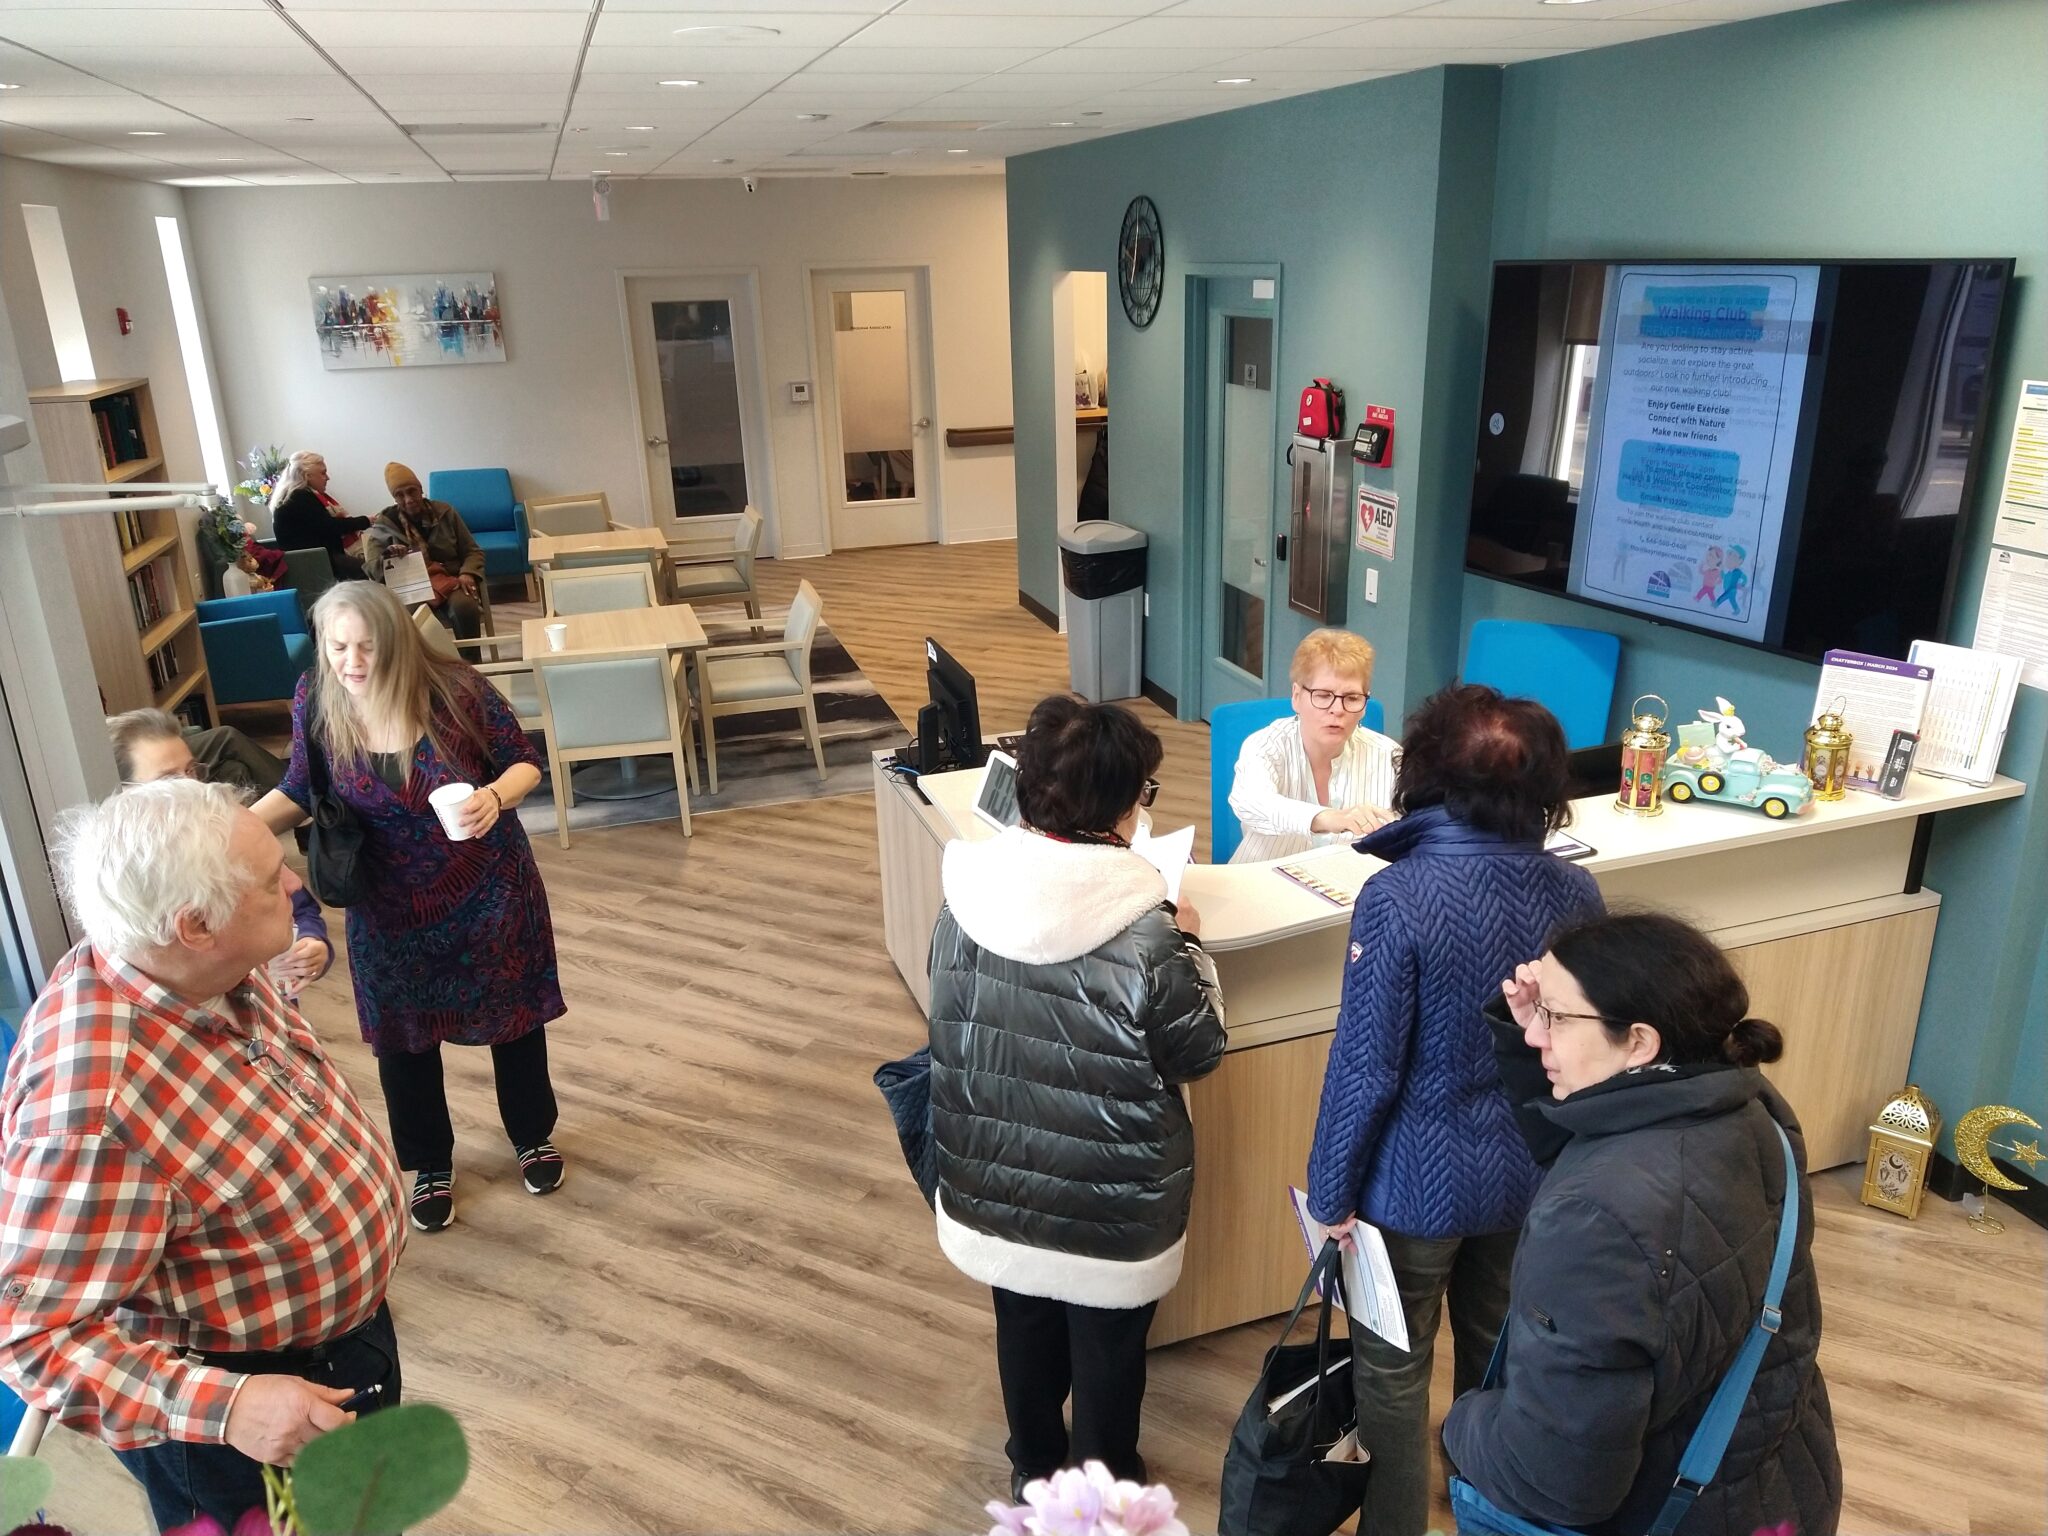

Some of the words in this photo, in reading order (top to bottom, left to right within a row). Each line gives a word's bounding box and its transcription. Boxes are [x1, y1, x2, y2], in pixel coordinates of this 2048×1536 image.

[1658, 306, 1711, 322] Walking
[1716, 307, 1748, 321] Club
[1641, 342, 1654, 350] Are
[1656, 344, 1670, 352] you
[1671, 344, 1698, 354] looking
[1700, 345, 1708, 353] to
[1710, 346, 1726, 356] stay
[1671, 357, 1686, 366] and
[1688, 359, 1716, 370] explore
[1718, 360, 1731, 369] the
[1732, 362, 1754, 371] great
[1660, 370, 1677, 379] Look
[1722, 375, 1769, 388] Introducing
[1648, 399, 1669, 410] Enjoy
[1670, 401, 1695, 411] Gentle
[1697, 404, 1730, 415] Exercise
[1648, 413, 1679, 424] Connect
[1681, 415, 1697, 425] with
[1699, 418, 1726, 429] Nature
[1652, 427, 1672, 436] Make
[1673, 430, 1688, 438] new
[1690, 431, 1718, 442] friends
[1375, 508, 1393, 528] AED
[1831, 657, 1864, 666] CHATTERBOX
